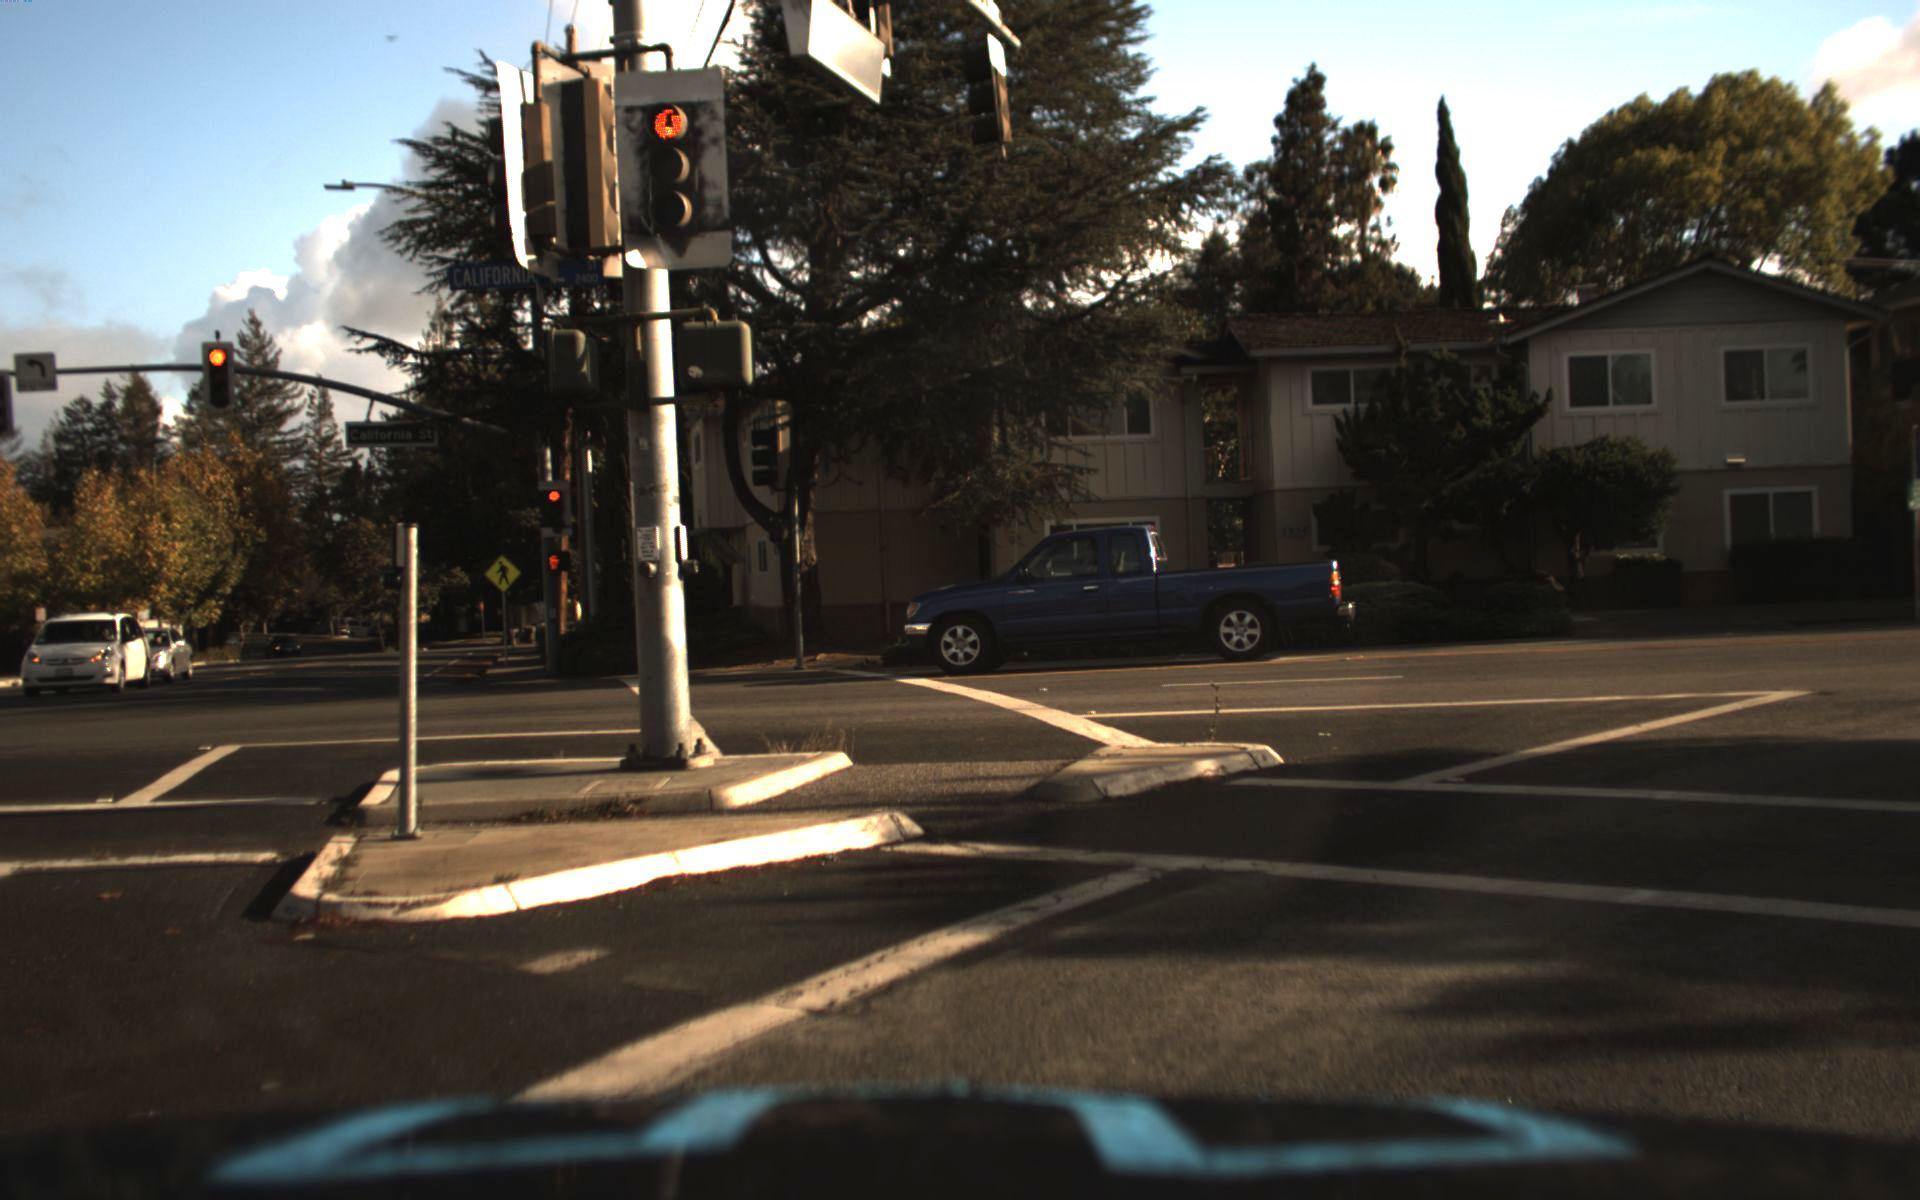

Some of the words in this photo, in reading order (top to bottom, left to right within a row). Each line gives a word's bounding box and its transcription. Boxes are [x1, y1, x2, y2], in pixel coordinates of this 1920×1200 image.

[453, 265, 536, 288] CALIFORNIA
[350, 428, 413, 441] California
[418, 428, 434, 441] St
